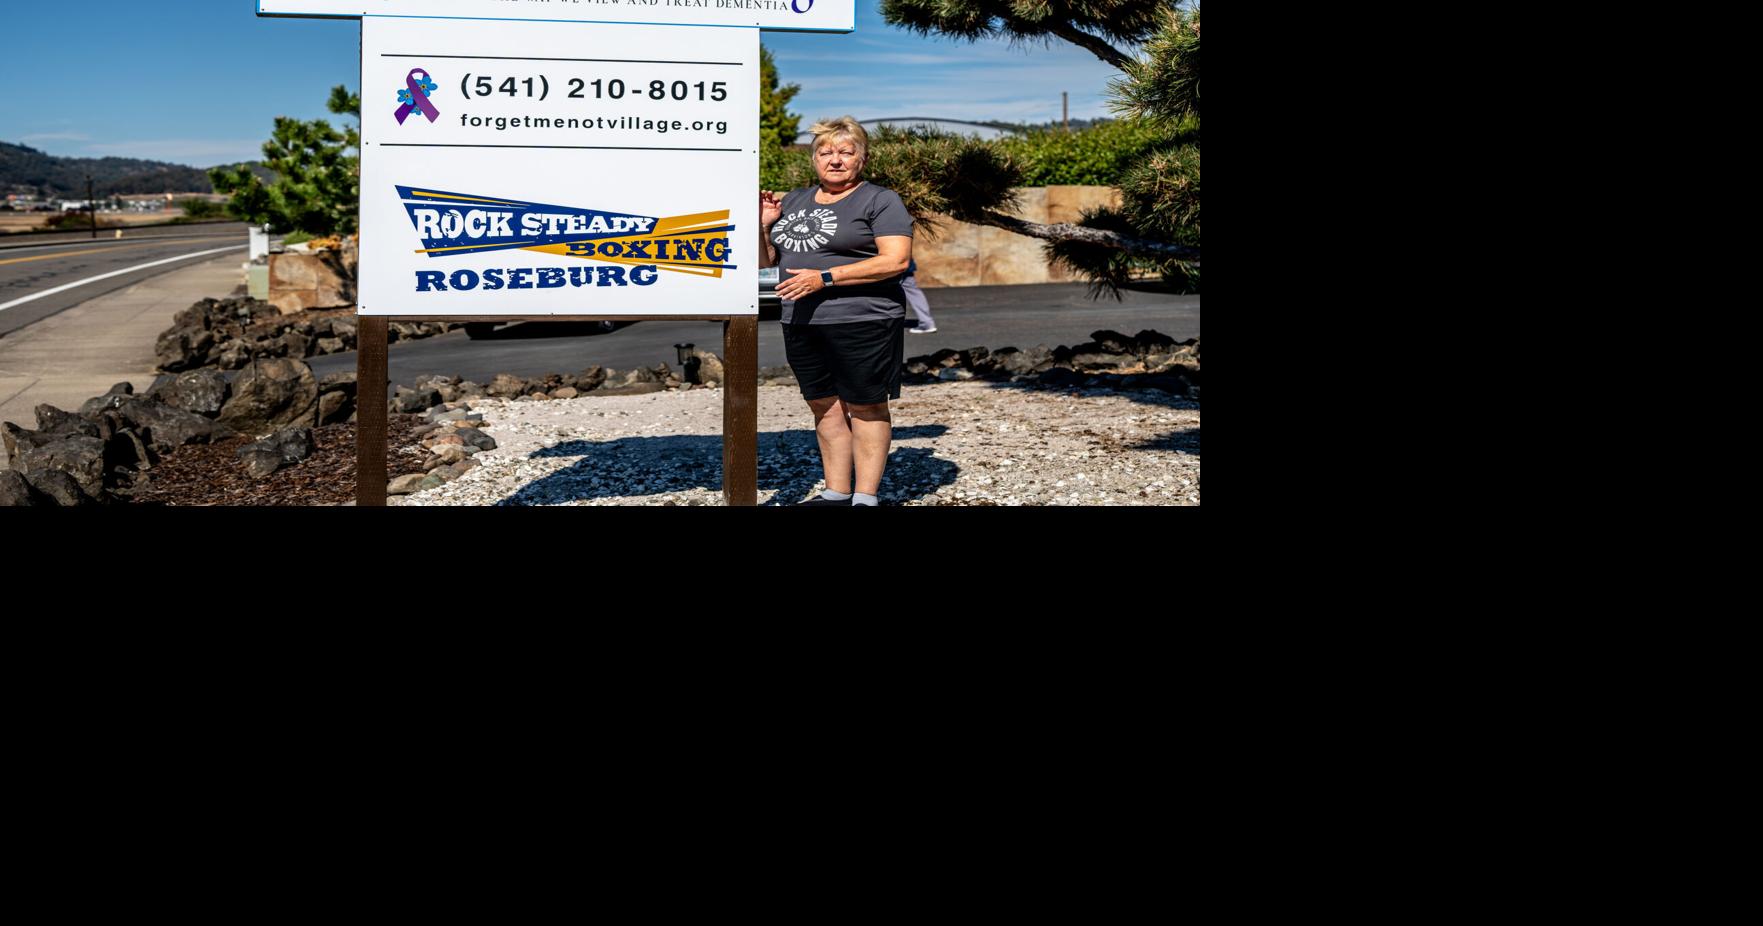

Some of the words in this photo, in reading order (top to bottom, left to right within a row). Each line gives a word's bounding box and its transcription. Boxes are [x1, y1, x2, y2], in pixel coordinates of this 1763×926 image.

[716, 0, 788, 10] DEMENTIA
[460, 73, 549, 102] (541)
[567, 78, 728, 102] 210-8015
[460, 113, 728, 135] forgetmenotvillage.org
[413, 208, 514, 240] ROCK
[521, 212, 655, 236] STEADY
[772, 209, 806, 233] ROCK
[809, 208, 838, 236] STEADY
[565, 237, 733, 262] BOXING
[774, 233, 830, 252] BOXING
[415, 264, 659, 292] ROSEBURG
